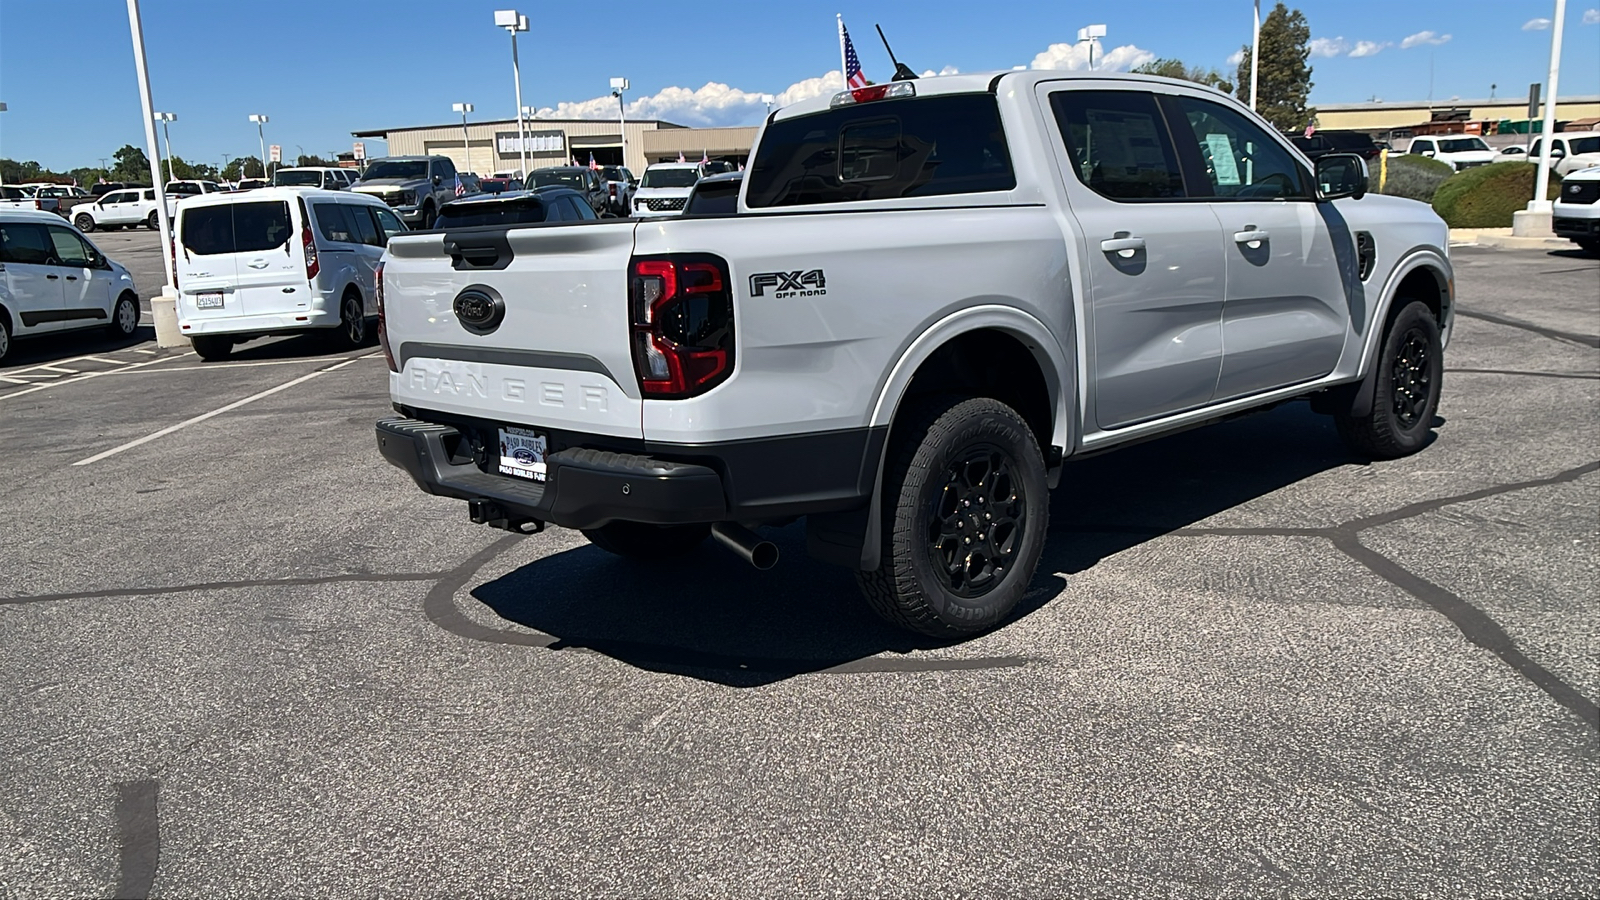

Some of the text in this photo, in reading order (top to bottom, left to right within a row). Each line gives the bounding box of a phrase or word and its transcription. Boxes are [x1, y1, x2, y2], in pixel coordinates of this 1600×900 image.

[748, 269, 826, 297] FX4
[775, 289, 826, 299] OFF ROAD
[459, 299, 485, 317] Ford
[409, 367, 608, 412] RANGER
[506, 436, 542, 455] PASO ROBLES
[499, 465, 513, 474] PASO
[513, 468, 533, 479] ROBLES
